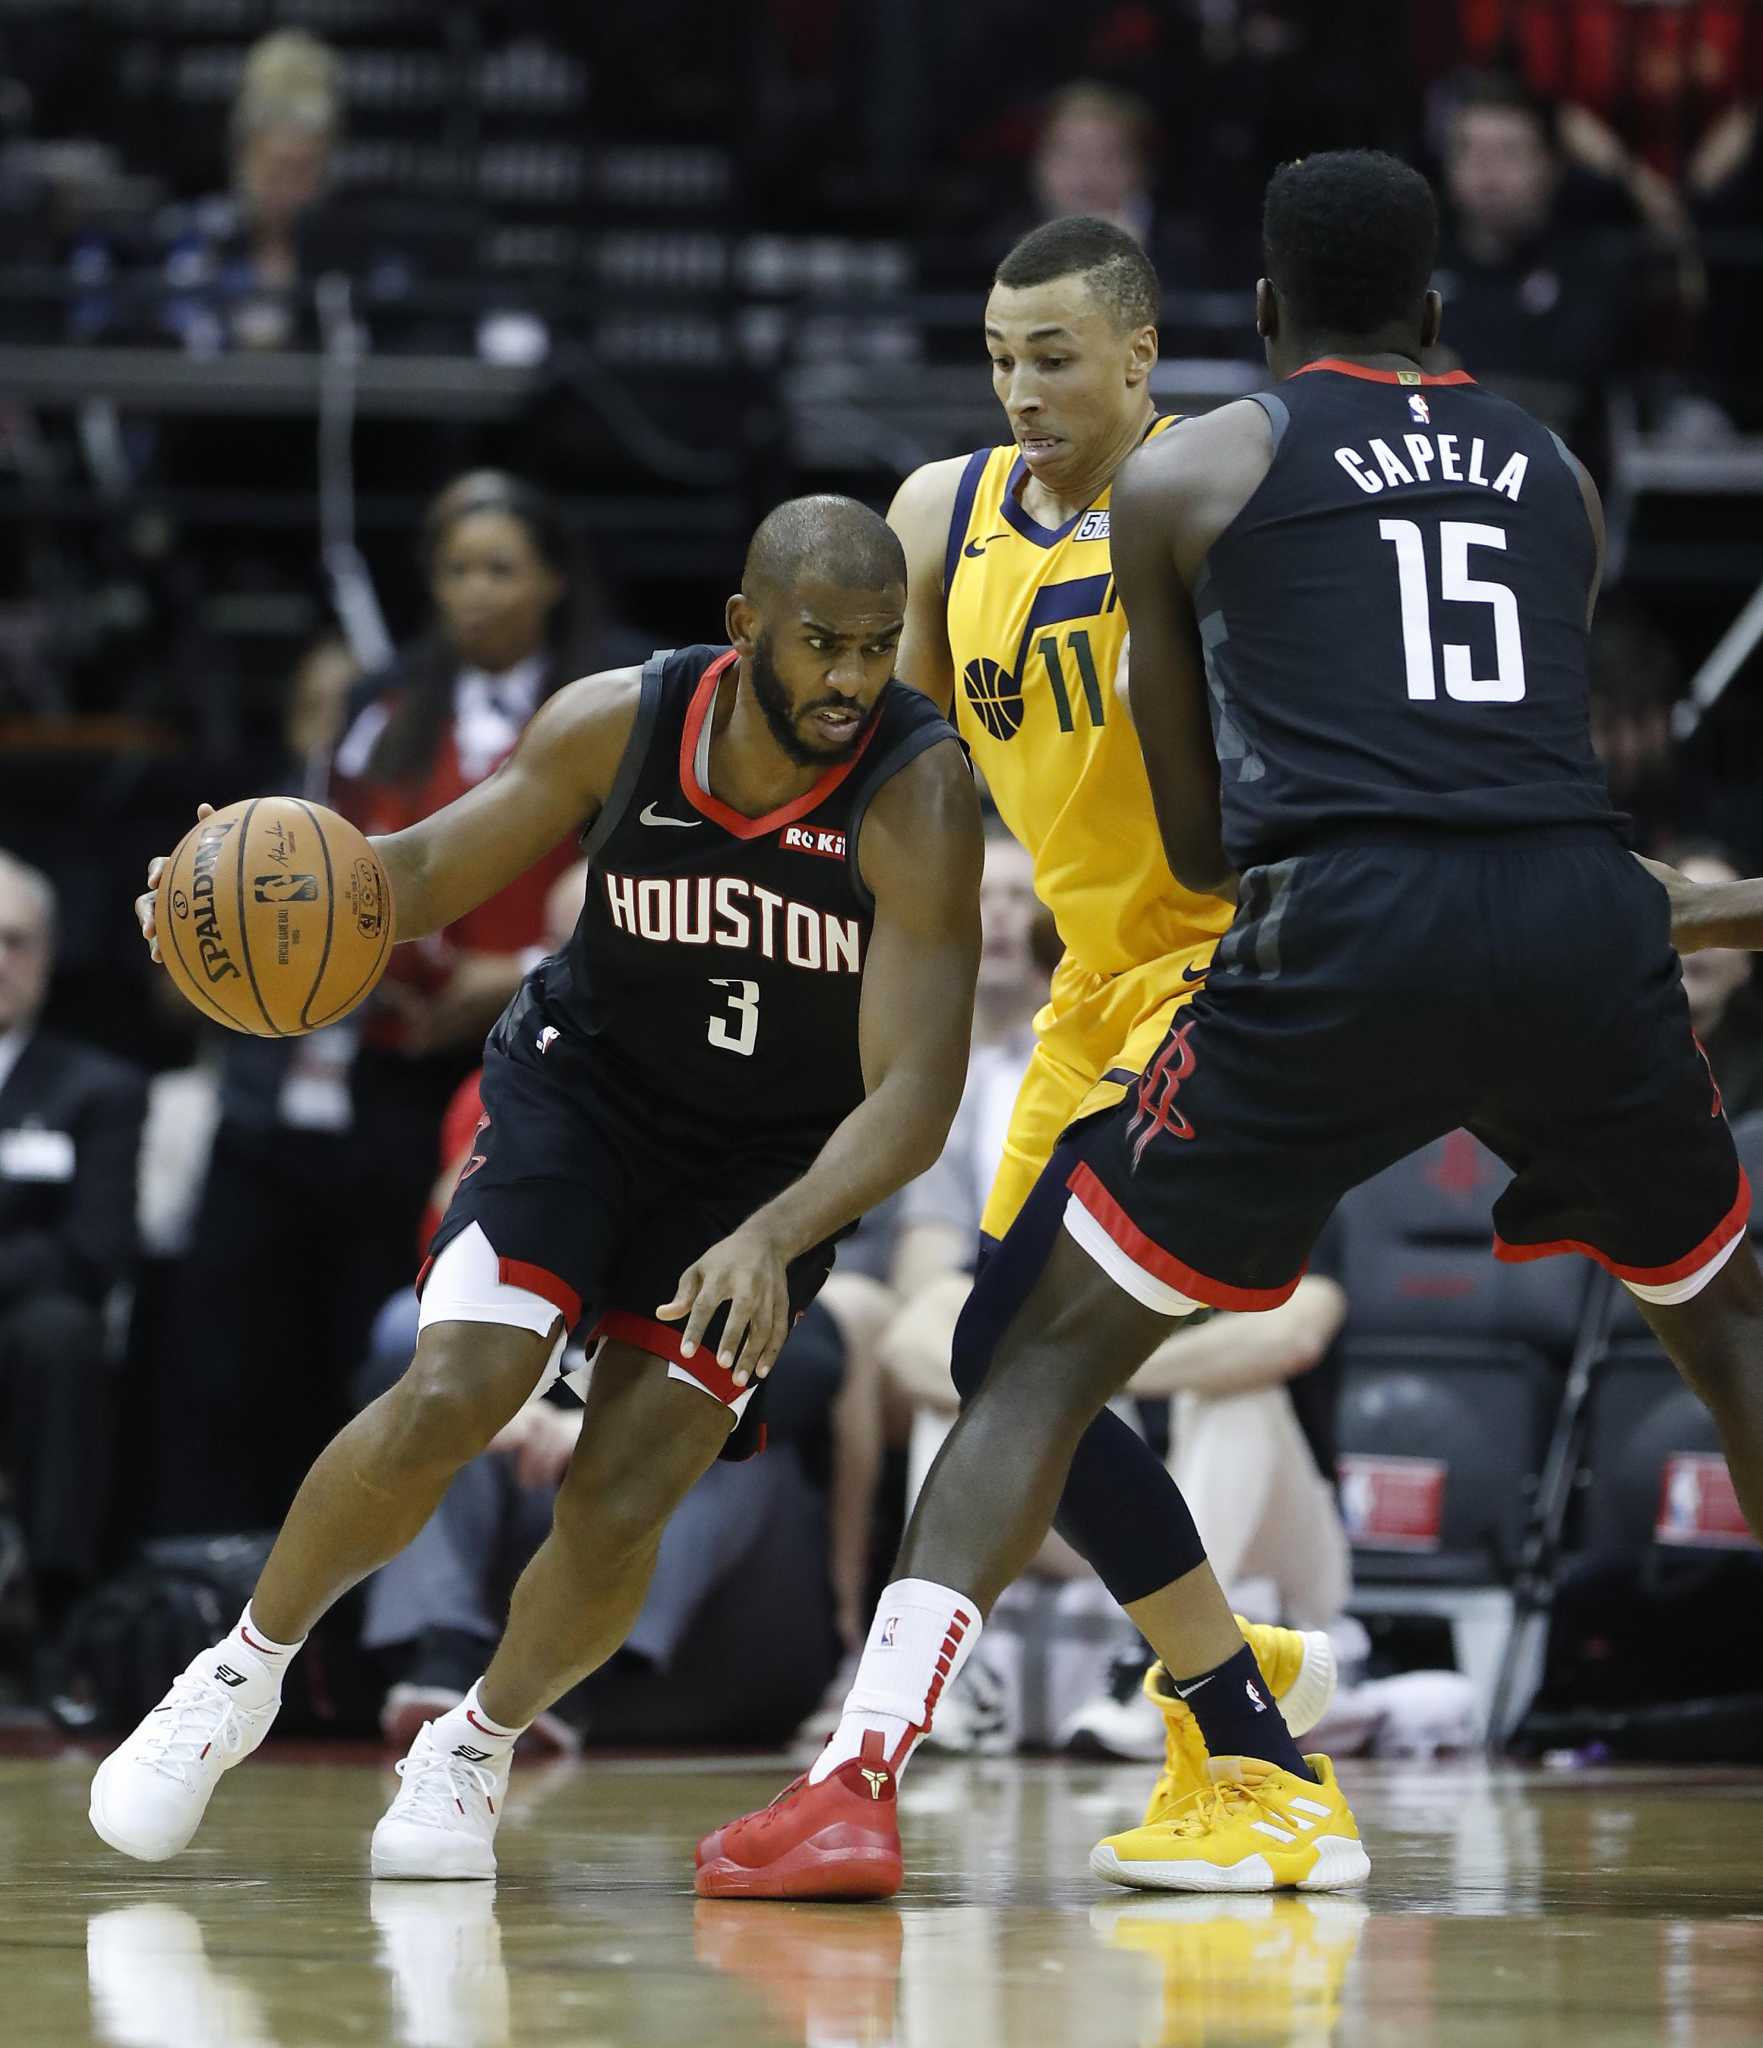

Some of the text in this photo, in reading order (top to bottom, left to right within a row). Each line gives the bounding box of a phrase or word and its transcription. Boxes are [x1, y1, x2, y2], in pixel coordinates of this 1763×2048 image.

[1334, 433, 1529, 502] CAPELA
[1378, 518, 1527, 703] 15
[1037, 630, 1105, 733] 11
[192, 821, 241, 983] SPALDING
[606, 872, 860, 974] HOUSTON
[707, 978, 760, 1057] 3
